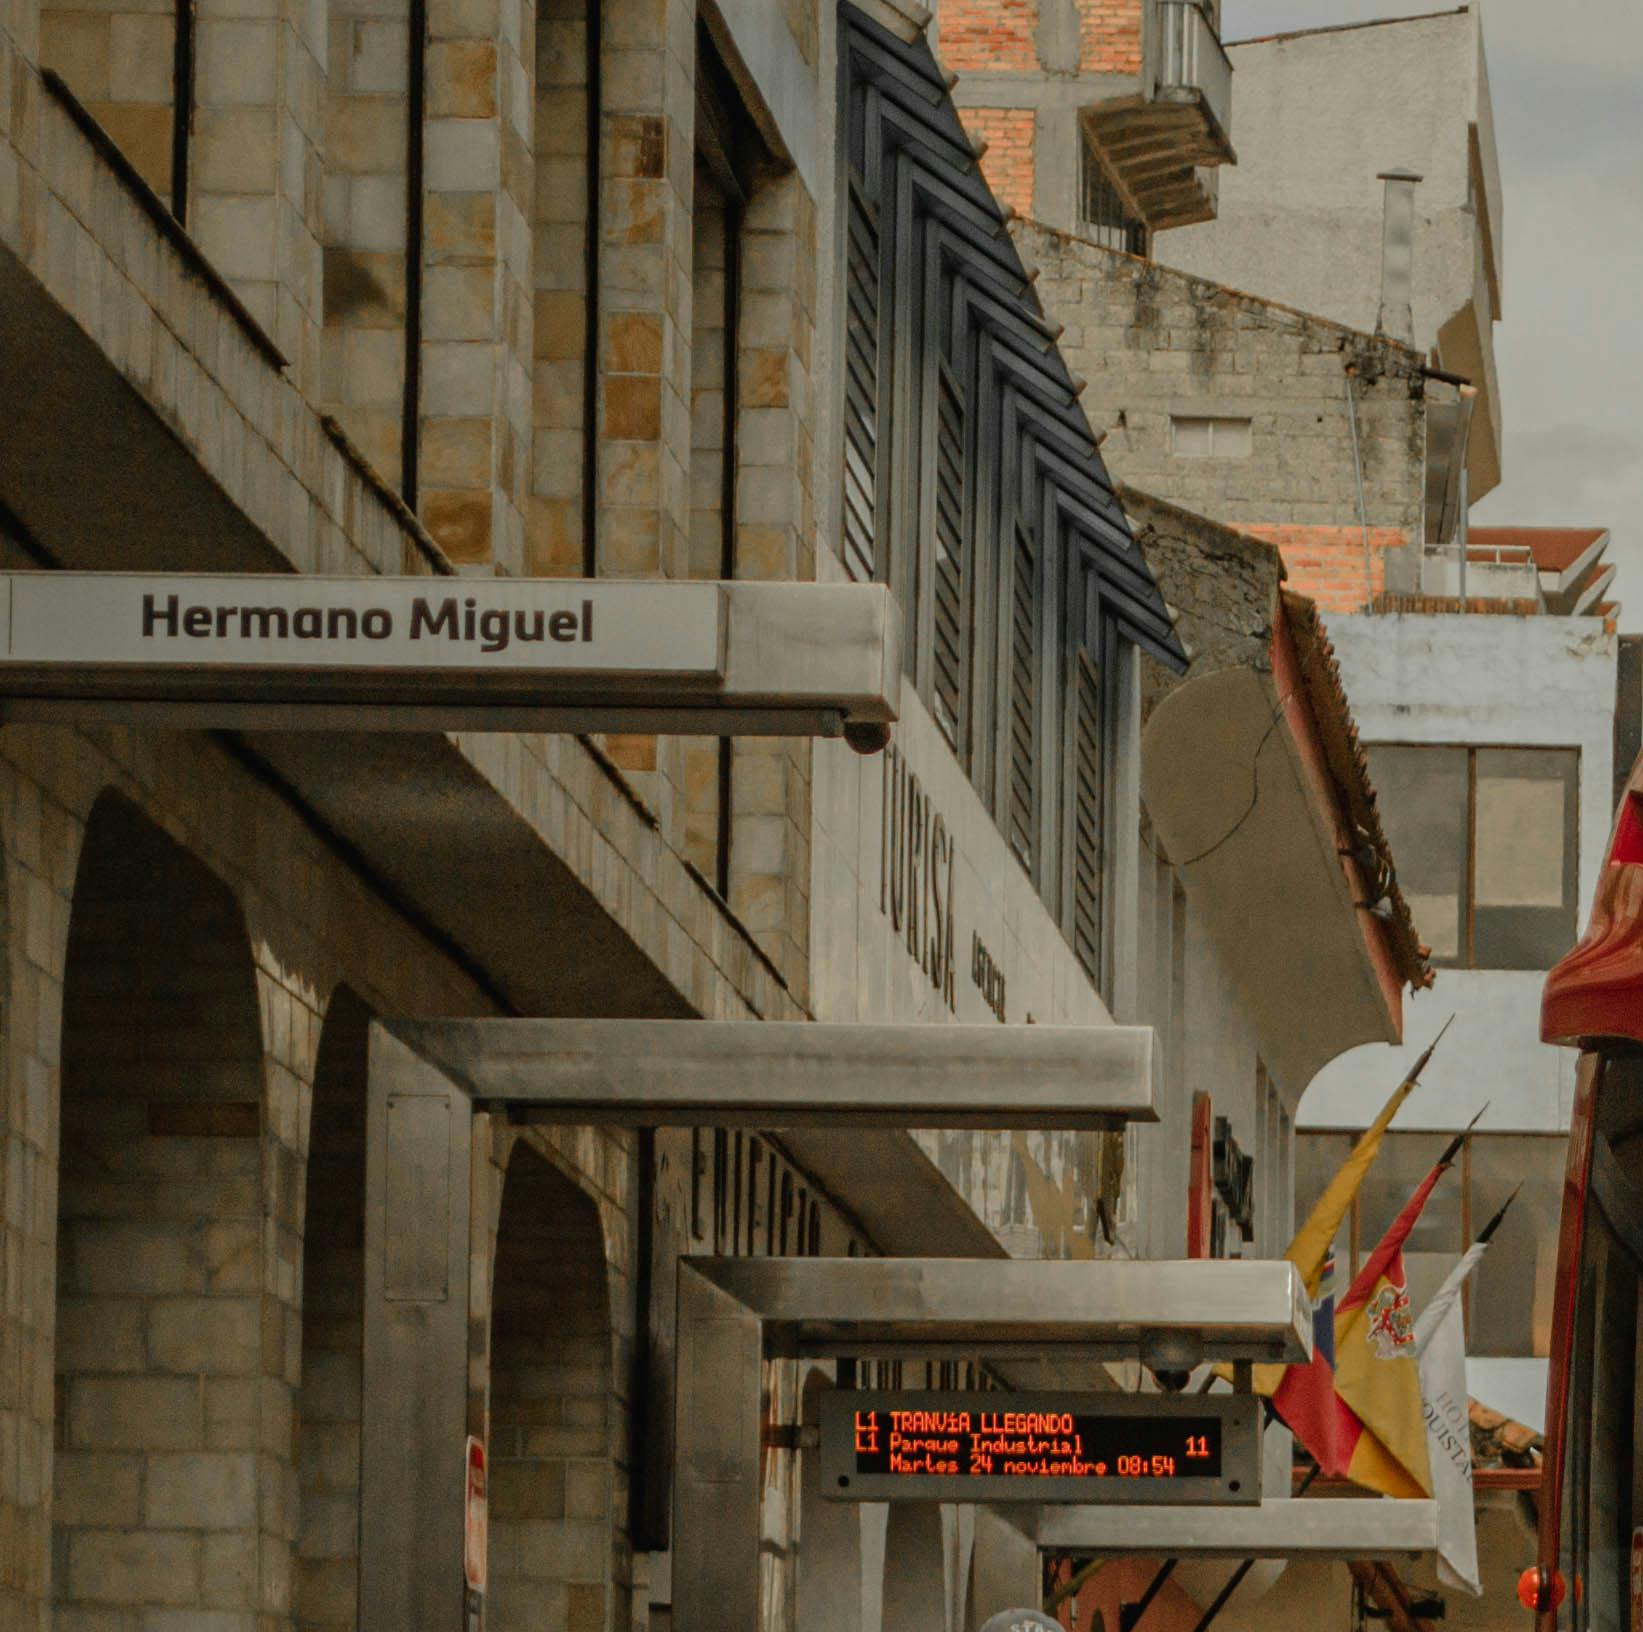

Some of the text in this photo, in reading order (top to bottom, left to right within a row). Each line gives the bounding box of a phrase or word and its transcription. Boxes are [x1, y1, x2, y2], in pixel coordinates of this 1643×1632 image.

[142, 594, 593, 652] Hermano Miguel
[855, 1411, 880, 1431] L1
[981, 1412, 1073, 1434] LLEGANDO
[855, 1431, 1209, 1456] L1 Parque Industrial 11
[889, 1453, 1175, 1476] Martes 24 noviembre 08:54
